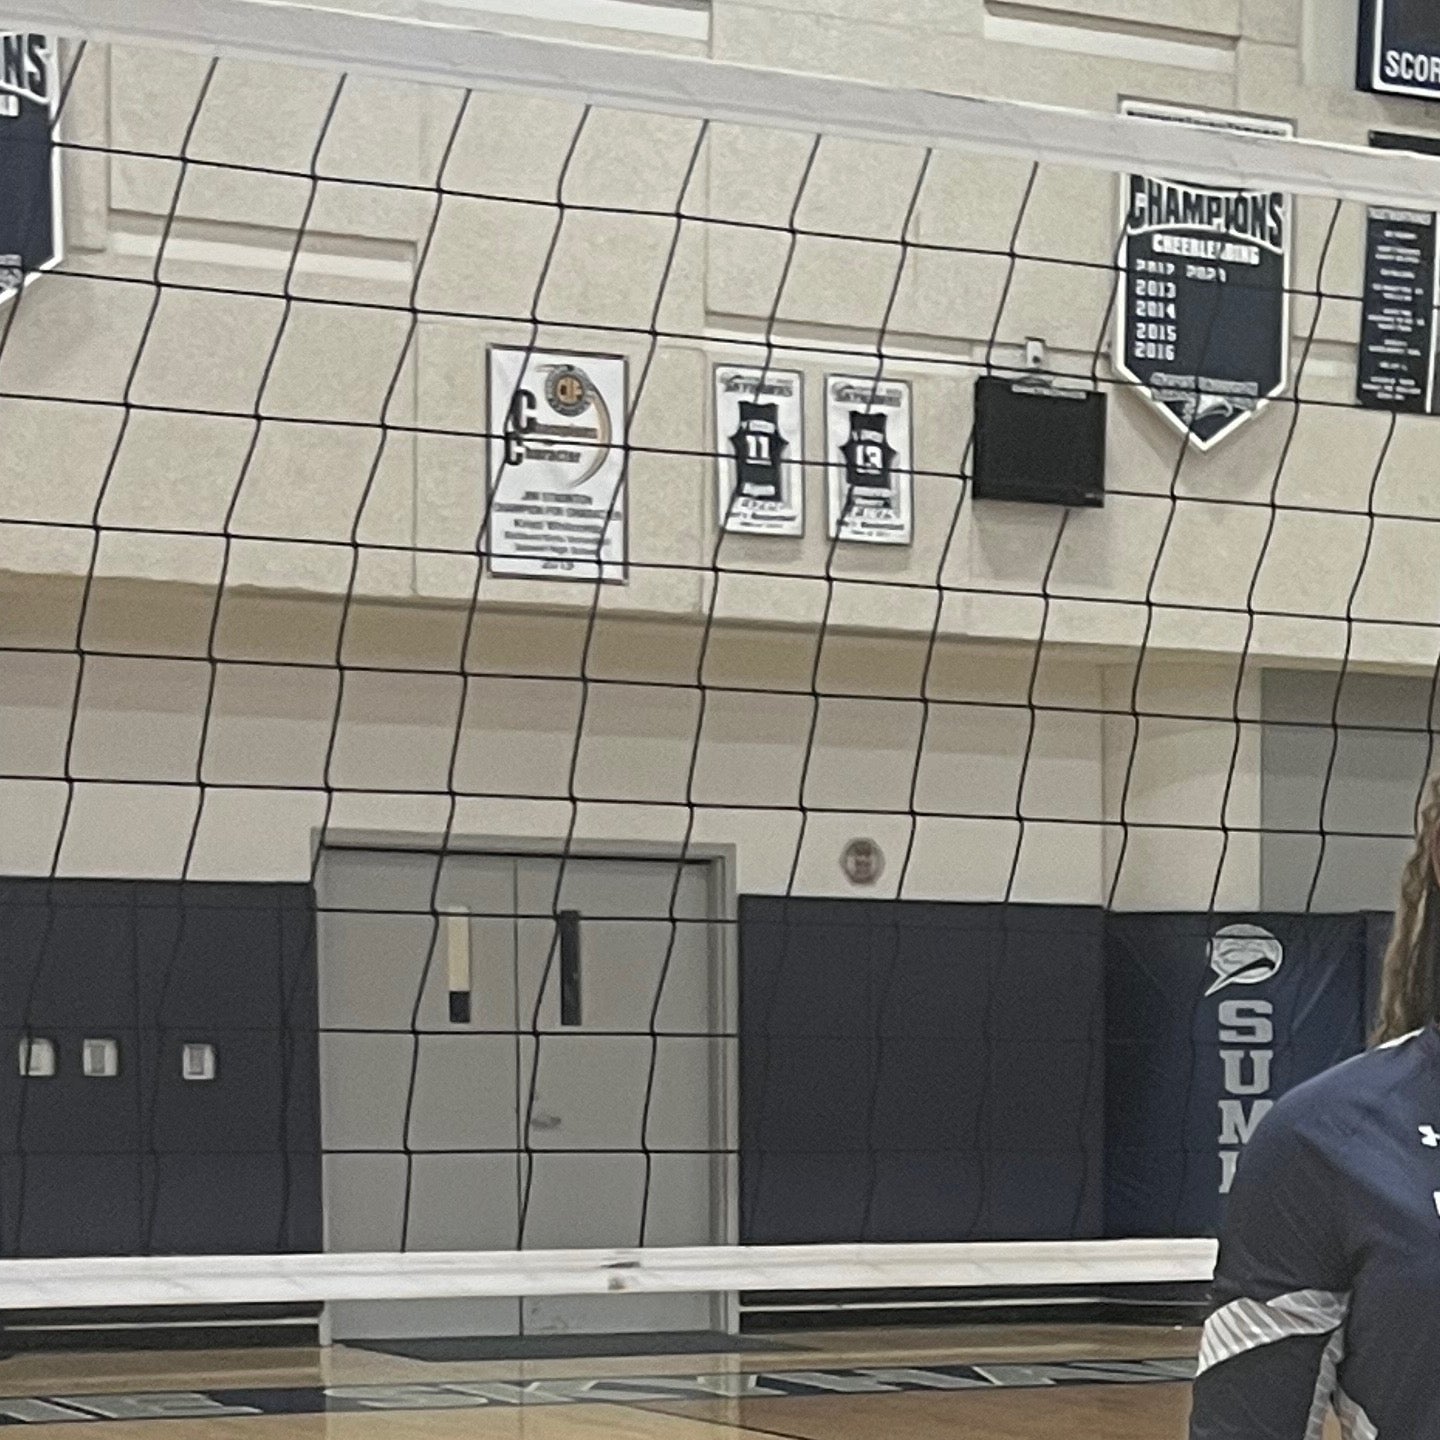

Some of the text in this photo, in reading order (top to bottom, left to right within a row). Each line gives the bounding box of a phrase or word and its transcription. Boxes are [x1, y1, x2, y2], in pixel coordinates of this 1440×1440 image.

[1130, 174, 1283, 248] CHAMPIONS
[1136, 322, 1177, 342] 2015
[1134, 341, 1175, 361] 2016
